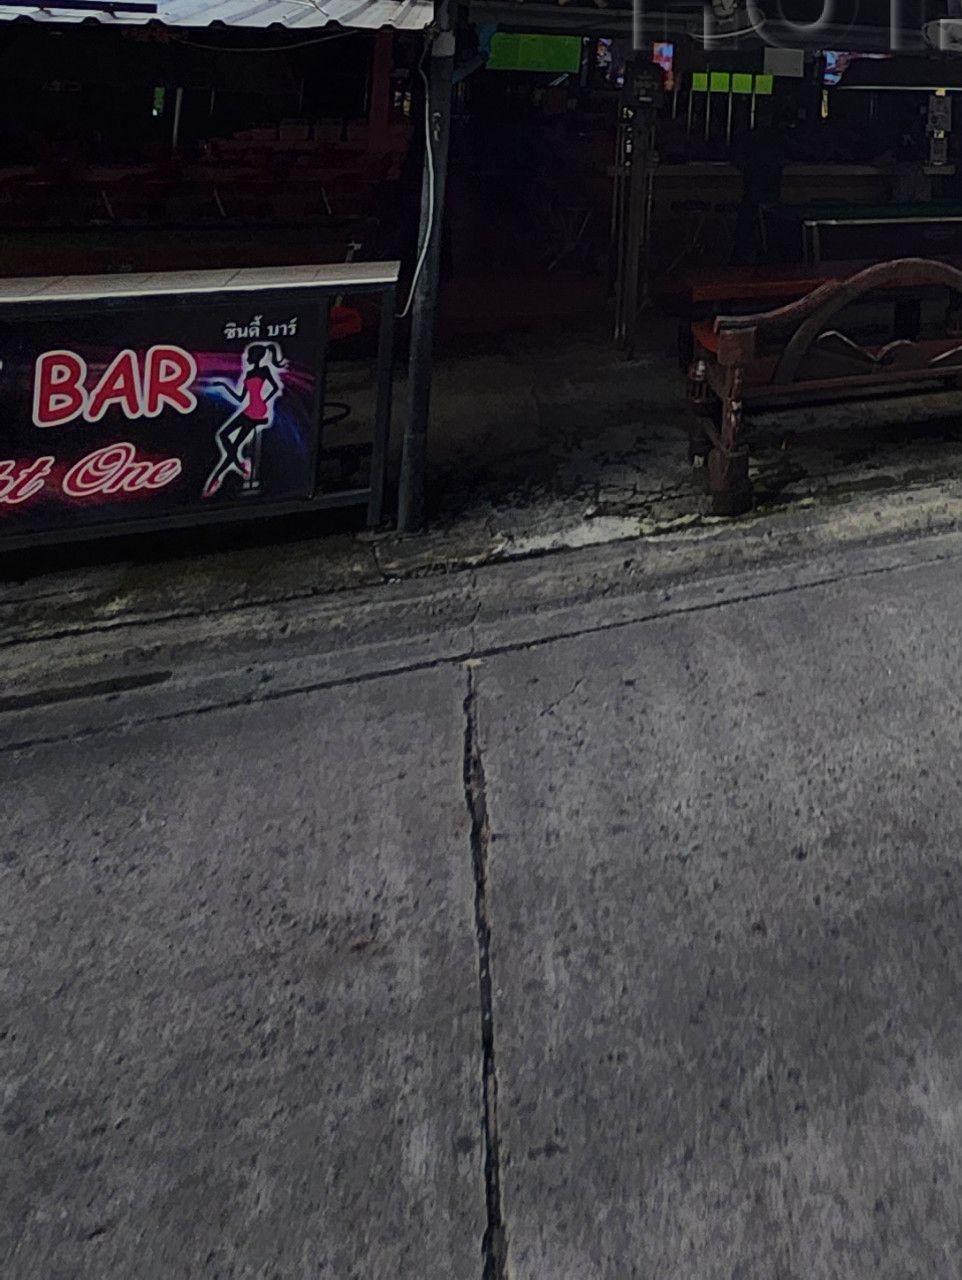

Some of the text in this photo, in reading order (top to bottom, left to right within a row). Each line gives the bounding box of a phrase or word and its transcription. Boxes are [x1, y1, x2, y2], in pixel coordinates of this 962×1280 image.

[266, 317, 298, 338] บาร์
[33, 344, 198, 428] BAR
[62, 441, 182, 497] One
